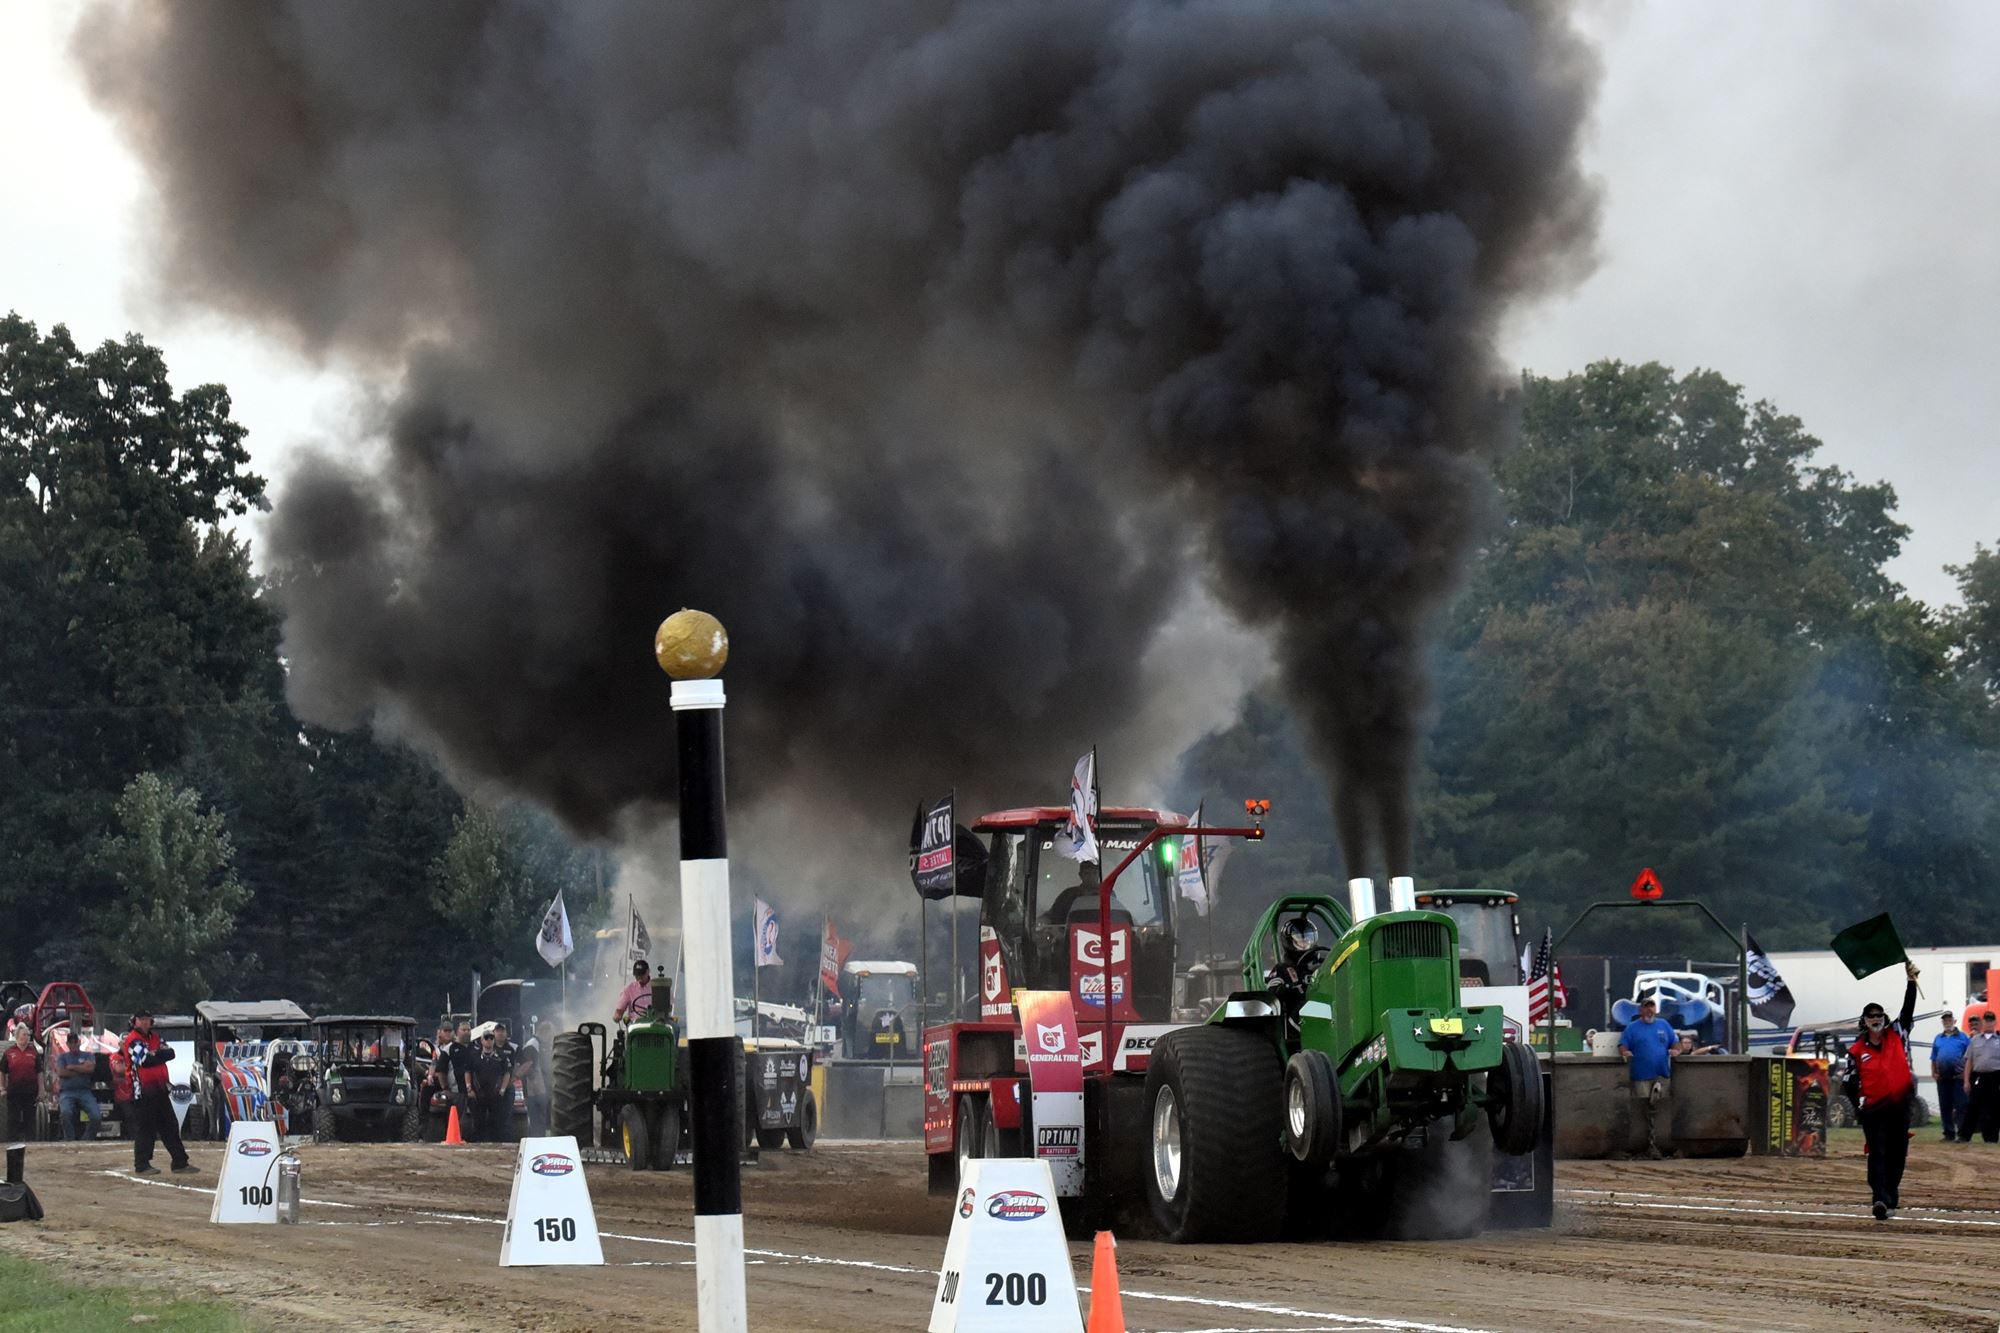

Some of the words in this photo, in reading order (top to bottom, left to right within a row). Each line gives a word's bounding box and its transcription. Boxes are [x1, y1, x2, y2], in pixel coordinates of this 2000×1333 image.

[1085, 983, 1121, 993] LUCS
[1030, 1054, 1062, 1062] GENERAL
[1063, 1054, 1079, 1062] TIRE
[1040, 1129, 1078, 1145] OPTIMA
[239, 1186, 273, 1205] 100
[534, 1218, 576, 1242] 150
[941, 1270, 960, 1304] 200
[985, 1272, 1047, 1306] 200
